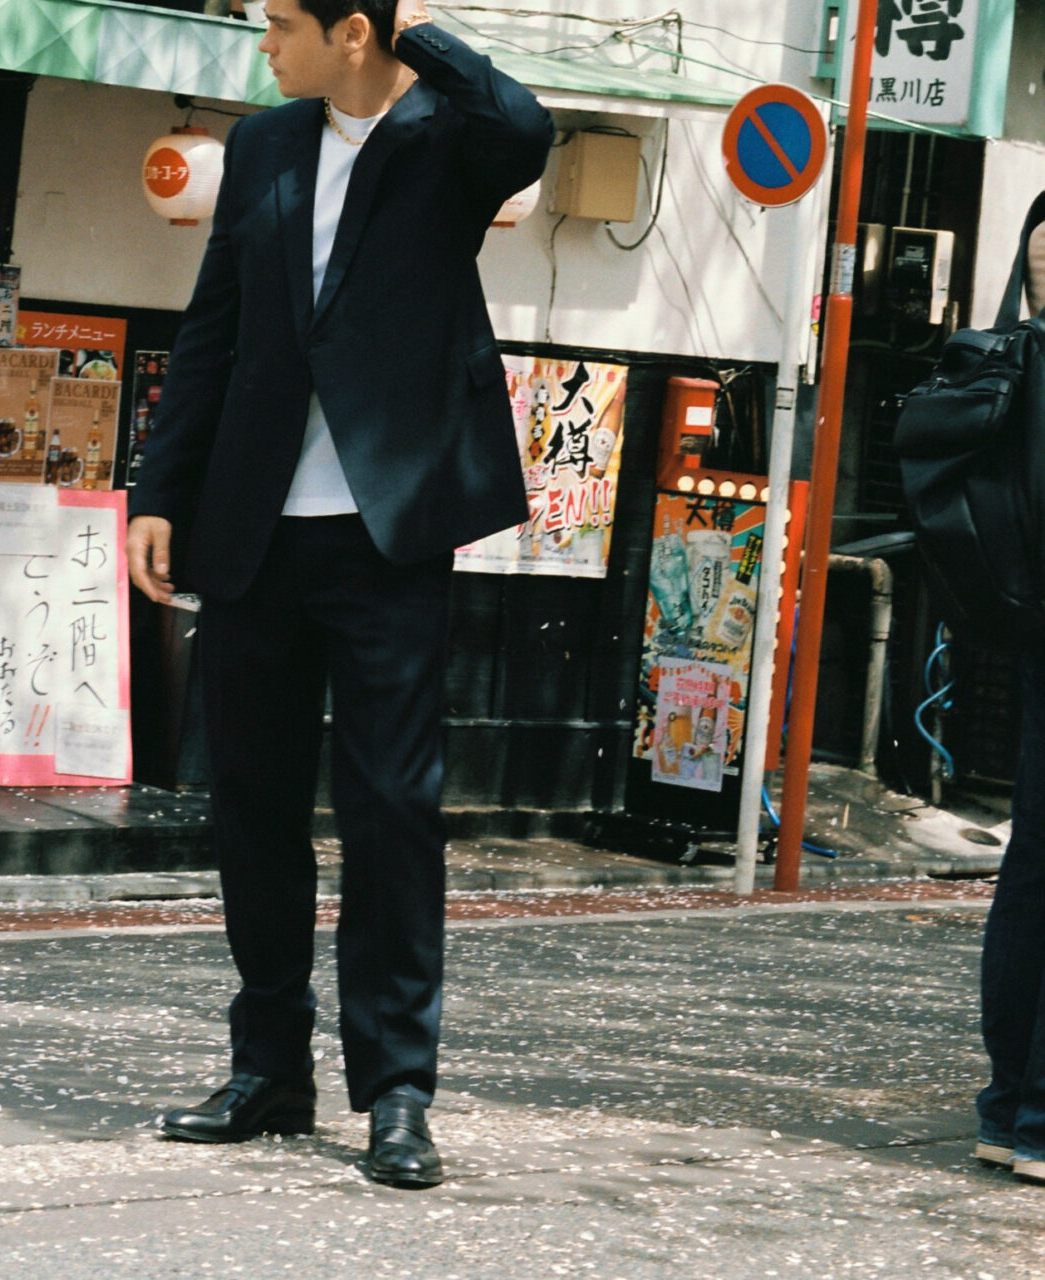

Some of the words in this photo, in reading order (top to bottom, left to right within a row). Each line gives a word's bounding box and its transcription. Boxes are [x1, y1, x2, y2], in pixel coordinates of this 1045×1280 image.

[867, 77, 947, 107] 黒川店
[31, 322, 116, 341] ランチメニュー
[55, 382, 120, 399] BACARDI
[544, 362, 594, 480] 大樽
[71, 525, 109, 708] お二階へ
